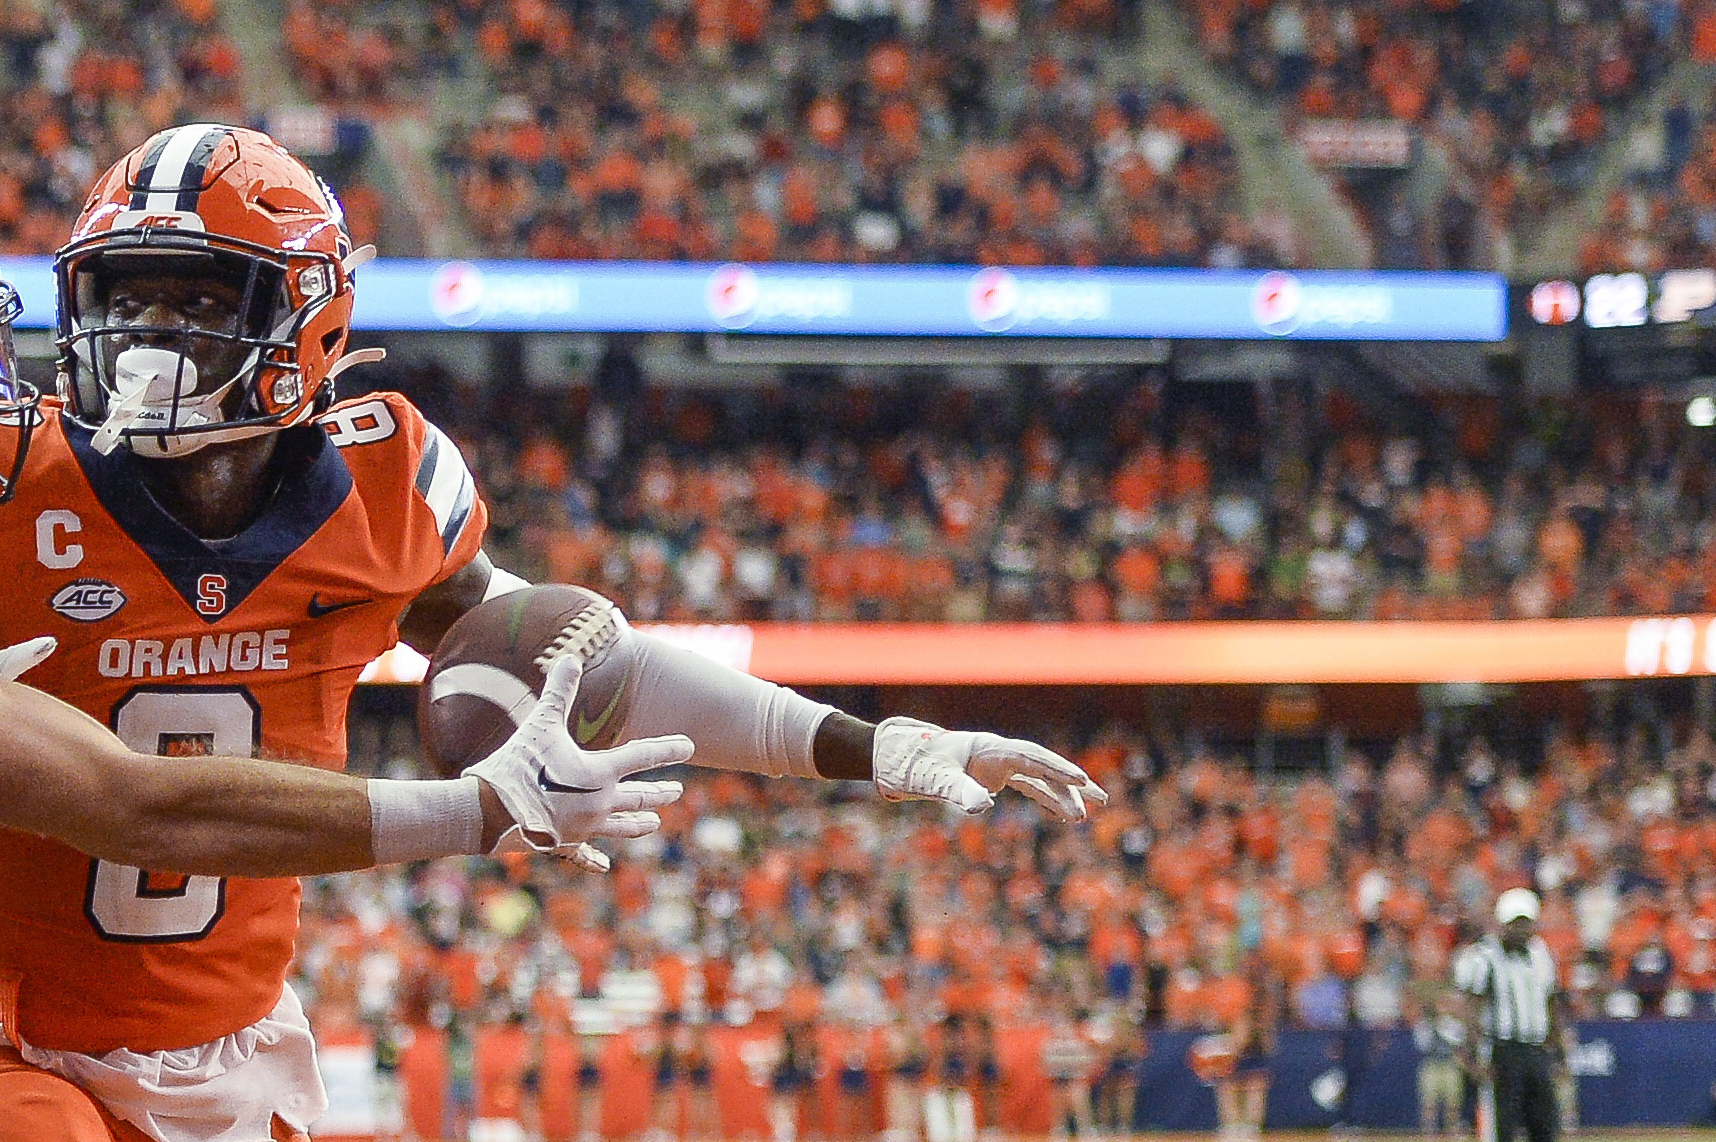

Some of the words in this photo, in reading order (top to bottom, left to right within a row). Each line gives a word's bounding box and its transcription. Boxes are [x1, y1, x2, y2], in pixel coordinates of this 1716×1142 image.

[316, 399, 398, 447] 8
[36, 509, 83, 569] C
[61, 589, 116, 606] ACC
[196, 574, 227, 615] S
[98, 629, 290, 677] ORANGE
